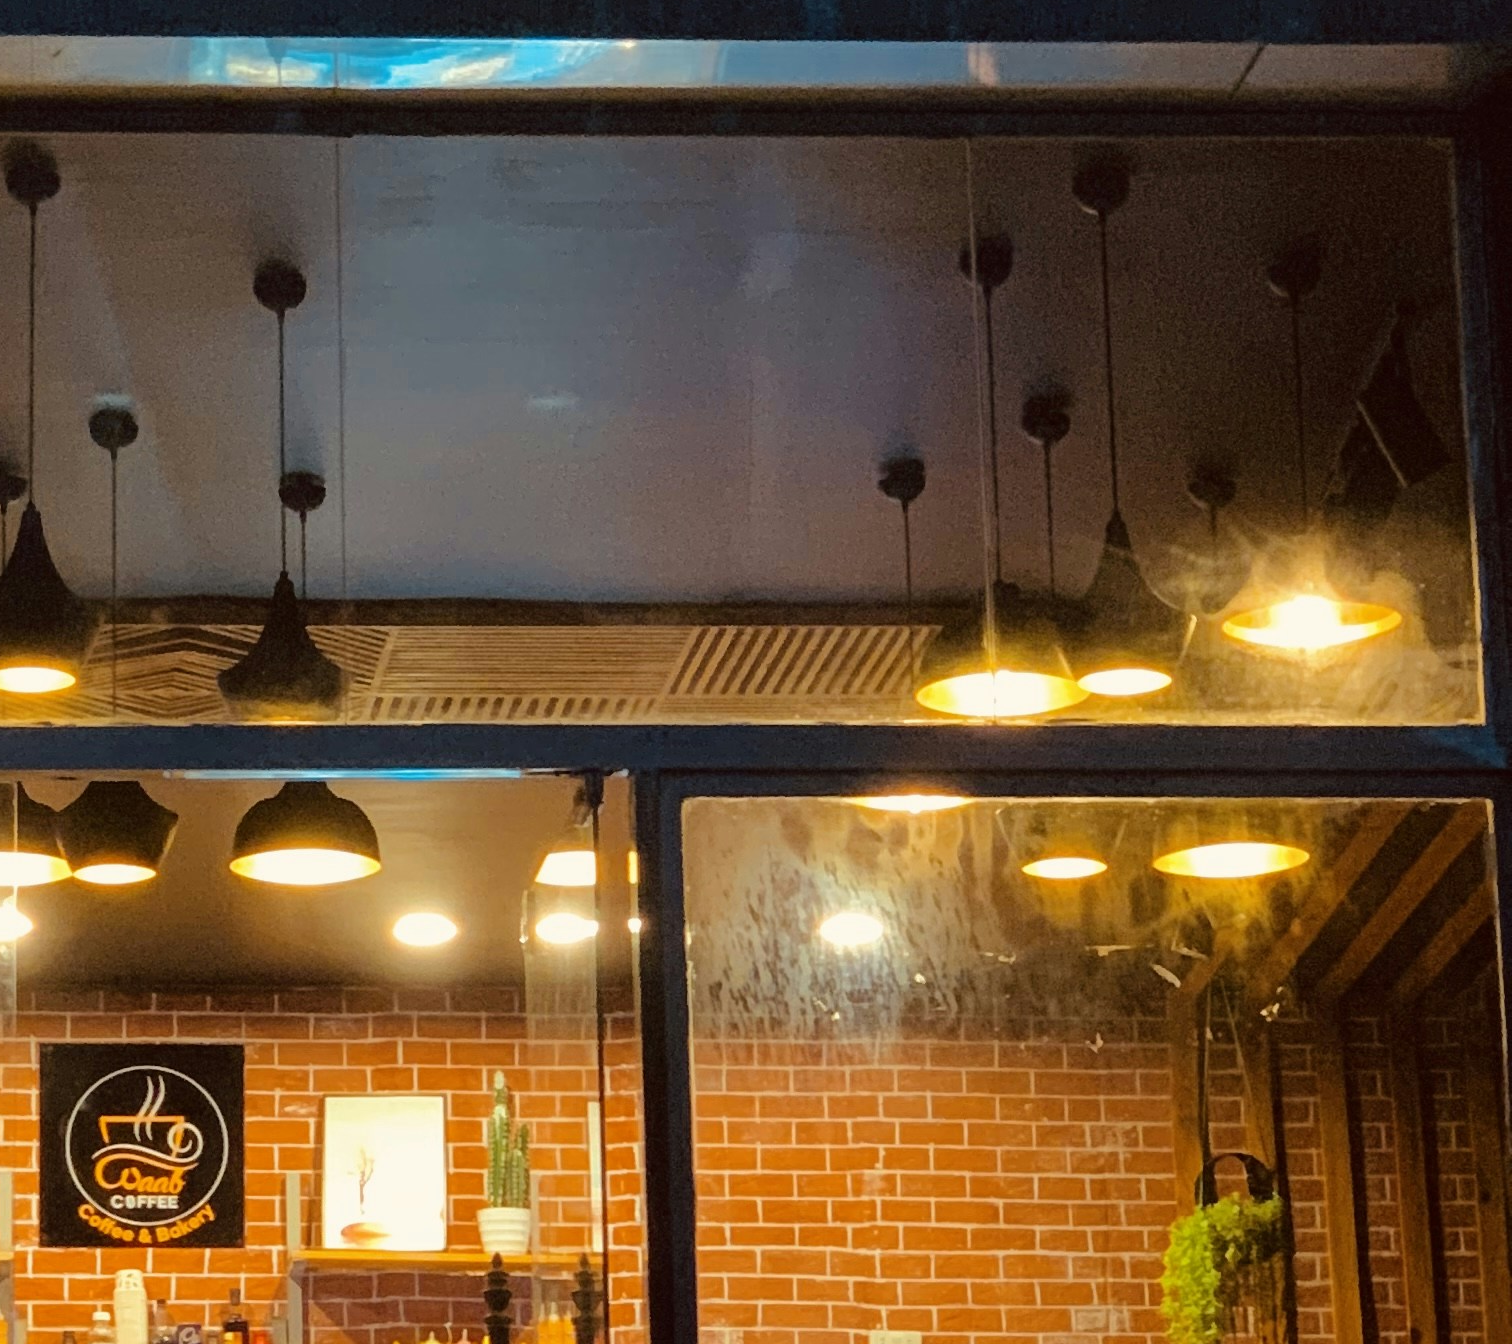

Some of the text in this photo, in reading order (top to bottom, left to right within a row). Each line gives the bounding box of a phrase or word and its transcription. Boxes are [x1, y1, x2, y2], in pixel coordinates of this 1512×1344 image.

[110, 1195, 179, 1209] COFFEE
[77, 1203, 216, 1244] Coffee & Bakery
